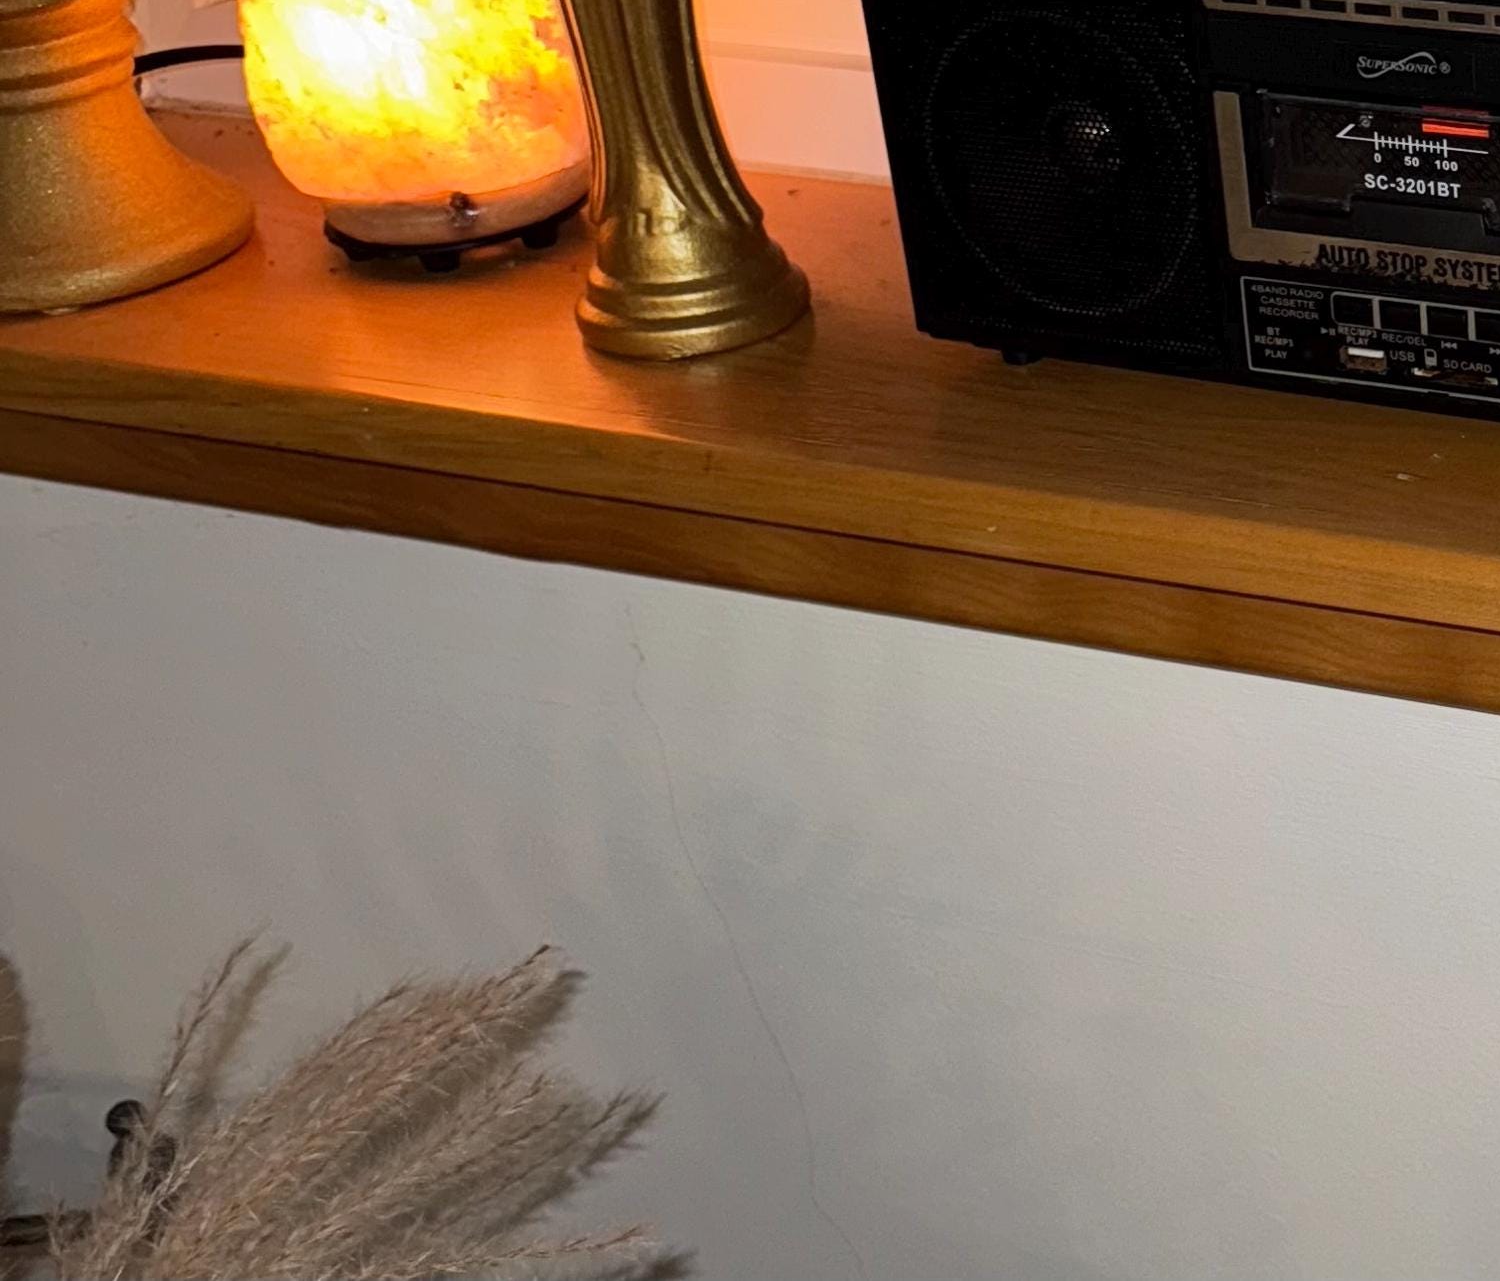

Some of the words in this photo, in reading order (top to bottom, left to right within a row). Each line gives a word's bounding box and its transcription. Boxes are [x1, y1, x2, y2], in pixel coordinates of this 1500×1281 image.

[1374, 152, 1382, 163] 0
[1404, 156, 1420, 167] 50
[1434, 160, 1458, 172] 100
[1364, 173, 1461, 198] SC-3201BT
[1317, 244, 1369, 268] AUTO
[1377, 250, 1427, 275] STOP
[1260, 295, 1316, 310] CASSETTE
[1259, 306, 1320, 320] RECORDER
[1346, 336, 1369, 346] PLAY
[1381, 332, 1427, 346] REC/DEL
[1264, 348, 1288, 359] PLAY
[1389, 350, 1416, 363] USB
[1460, 360, 1493, 374] CARD
